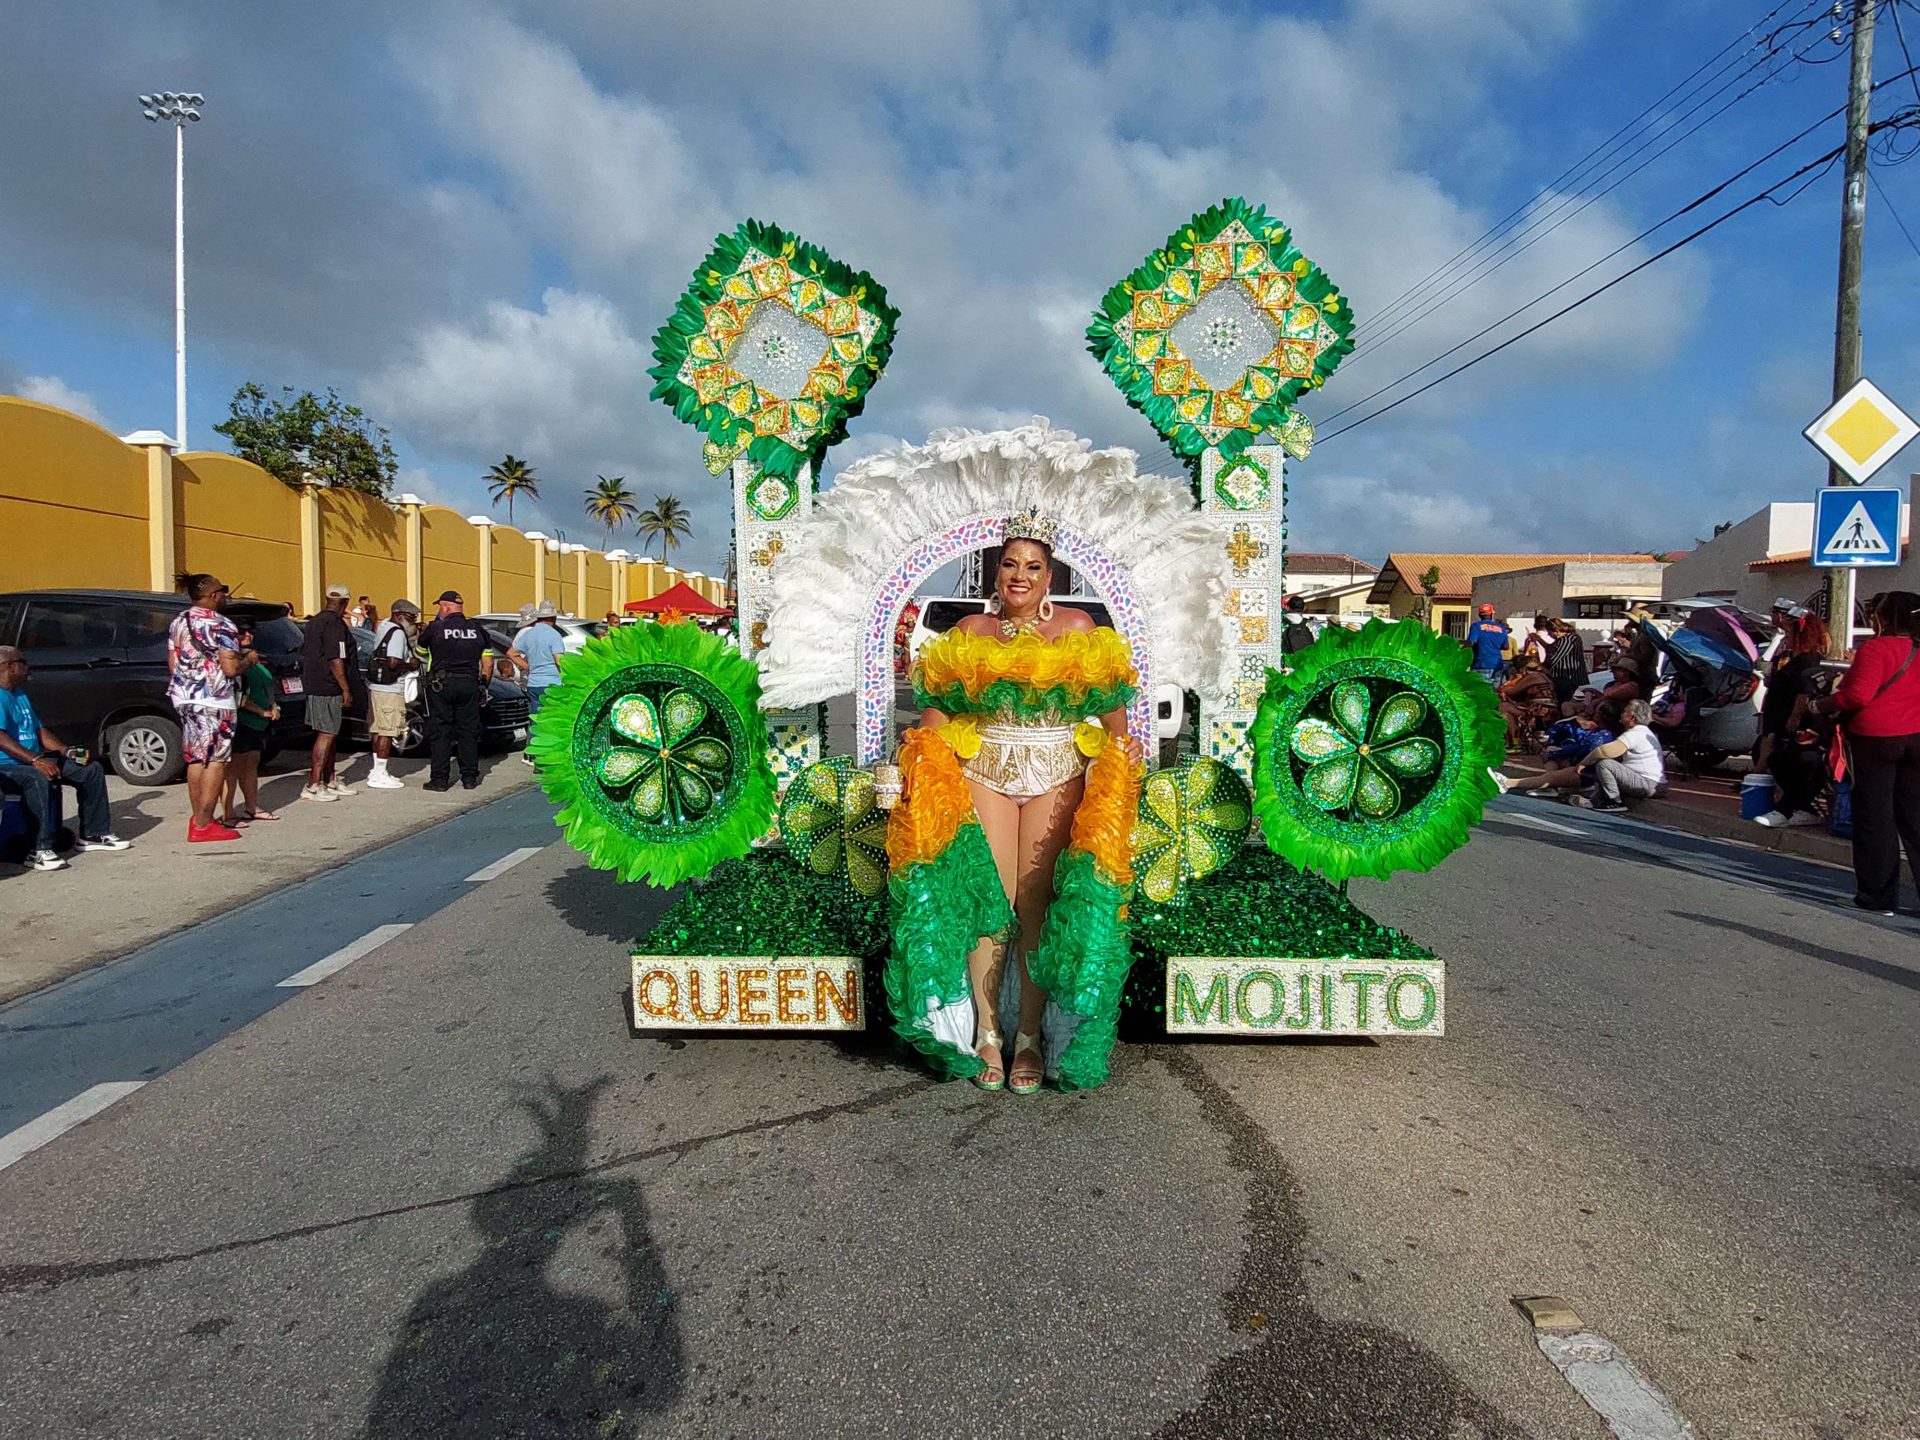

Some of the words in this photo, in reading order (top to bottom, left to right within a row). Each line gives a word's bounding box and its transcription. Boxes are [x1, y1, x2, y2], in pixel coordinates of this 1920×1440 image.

[444, 628, 477, 640] POLIS
[640, 969, 859, 1023] QUEEN
[1173, 969, 1437, 1030] MOJITO
